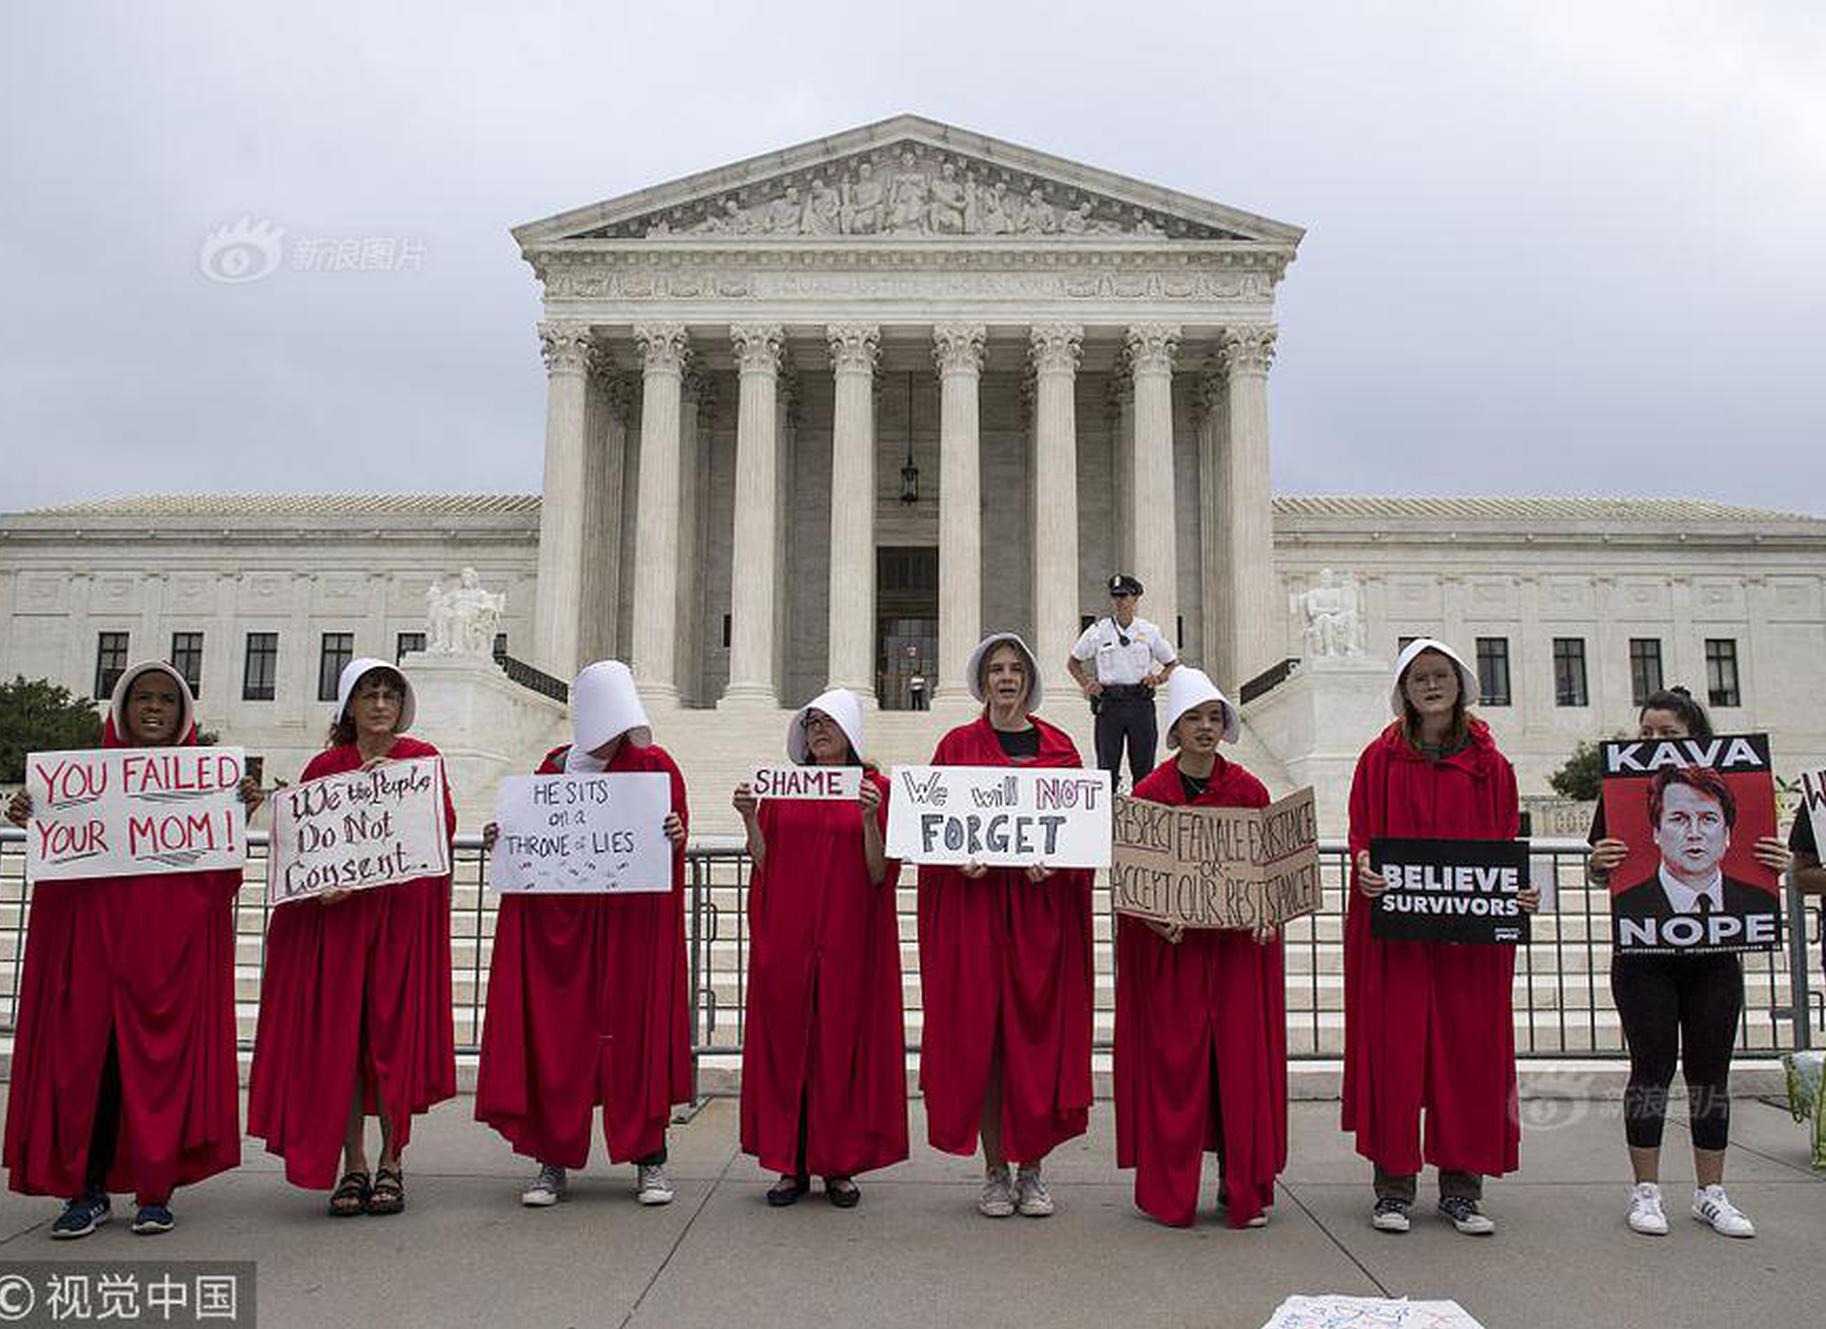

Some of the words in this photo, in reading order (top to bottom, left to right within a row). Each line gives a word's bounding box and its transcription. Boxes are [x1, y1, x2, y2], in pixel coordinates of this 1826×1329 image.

[1607, 738, 1763, 772] KAVA
[36, 759, 107, 803] YOU
[123, 756, 240, 794] FAILED
[289, 783, 341, 823] We
[370, 766, 431, 805] People
[534, 782, 560, 805] HE
[565, 780, 609, 804] SITS
[755, 769, 843, 796] SHAME
[902, 771, 948, 807] We
[972, 776, 1018, 808] will
[1036, 778, 1102, 810] NOT
[298, 823, 336, 854] Do
[343, 810, 394, 845] Not
[549, 812, 569, 827] on
[574, 810, 586, 824] a
[921, 815, 1067, 855] FORGET
[1113, 796, 1173, 851] RESPECT
[1178, 812, 1246, 862] FEMALE
[37, 819, 109, 859] YOUR
[506, 834, 570, 859] THRONE
[592, 832, 634, 854] LIES
[1112, 862, 1172, 913] ACCEPT
[1177, 873, 1224, 926] OUR
[1383, 865, 1518, 892] BELIEVE
[1382, 896, 1519, 917] SURVIVORS
[1619, 913, 1775, 946] NOPE
